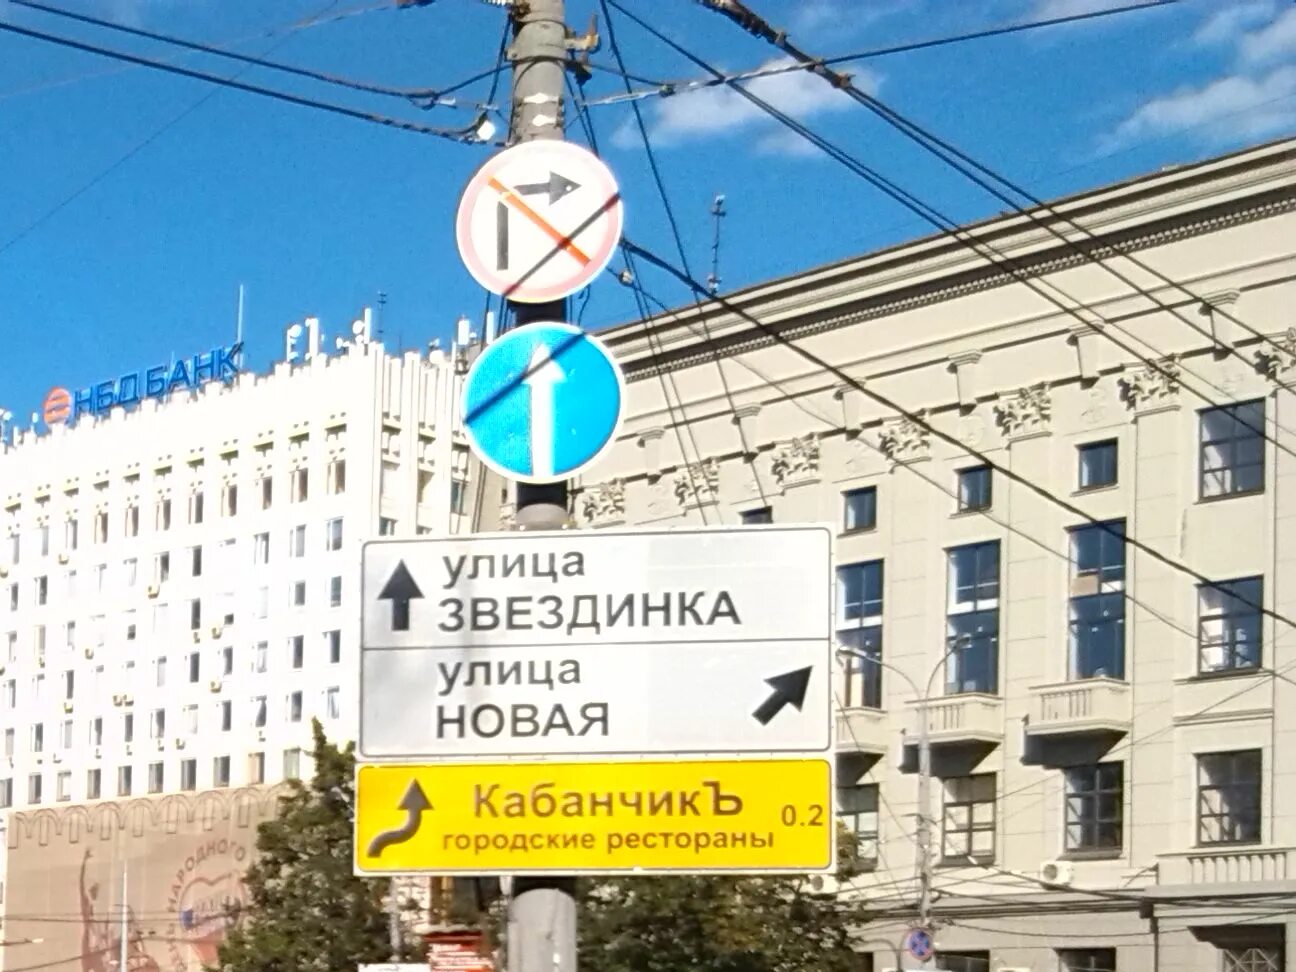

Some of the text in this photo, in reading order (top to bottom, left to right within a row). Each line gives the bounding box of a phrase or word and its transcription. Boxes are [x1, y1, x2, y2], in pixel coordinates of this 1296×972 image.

[442, 550, 585, 589] улица
[437, 590, 742, 635] ЗВЕЗДИНКА
[437, 658, 581, 697] улица
[435, 702, 610, 739] НОВАЯ
[473, 780, 744, 819] КабанчикЪ
[780, 804, 824, 828] 0.2
[442, 830, 774, 854] городские рестораны
